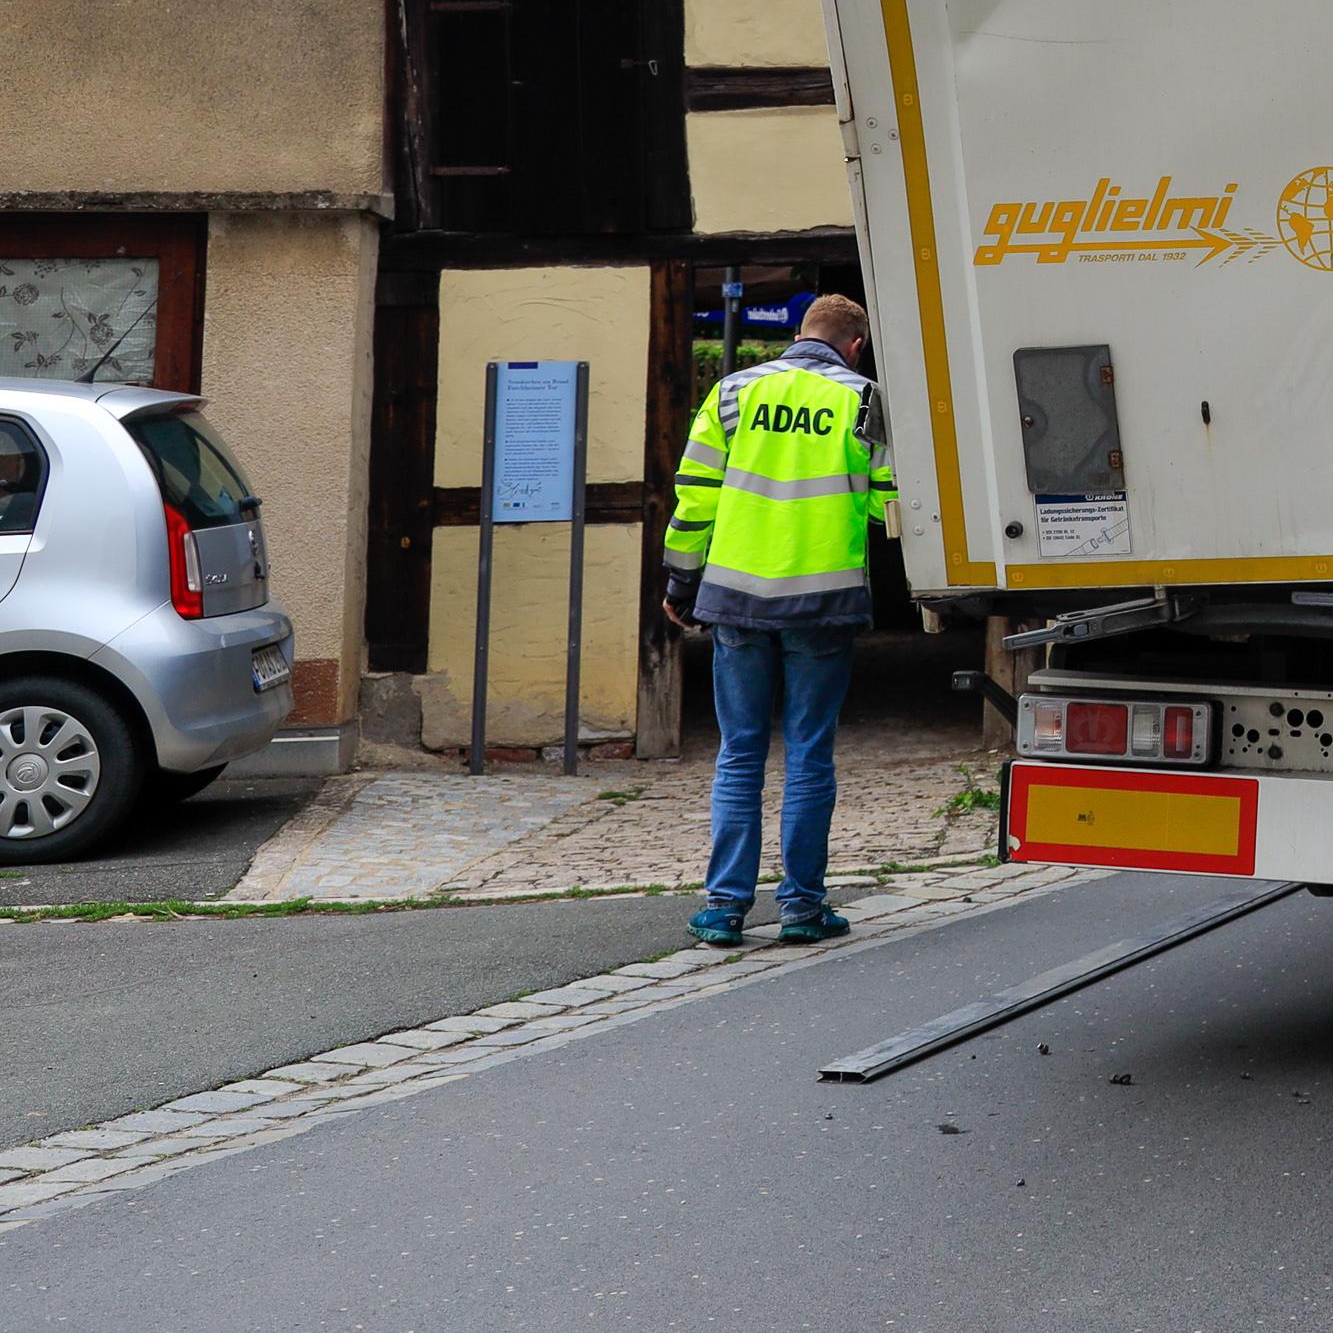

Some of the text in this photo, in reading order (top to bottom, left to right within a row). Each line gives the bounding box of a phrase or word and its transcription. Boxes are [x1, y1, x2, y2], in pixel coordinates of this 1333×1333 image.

[973, 176, 1239, 266] guglielmi
[1078, 252, 1187, 263] TRASPORTI DAL 1932
[750, 403, 835, 436] ADAC
